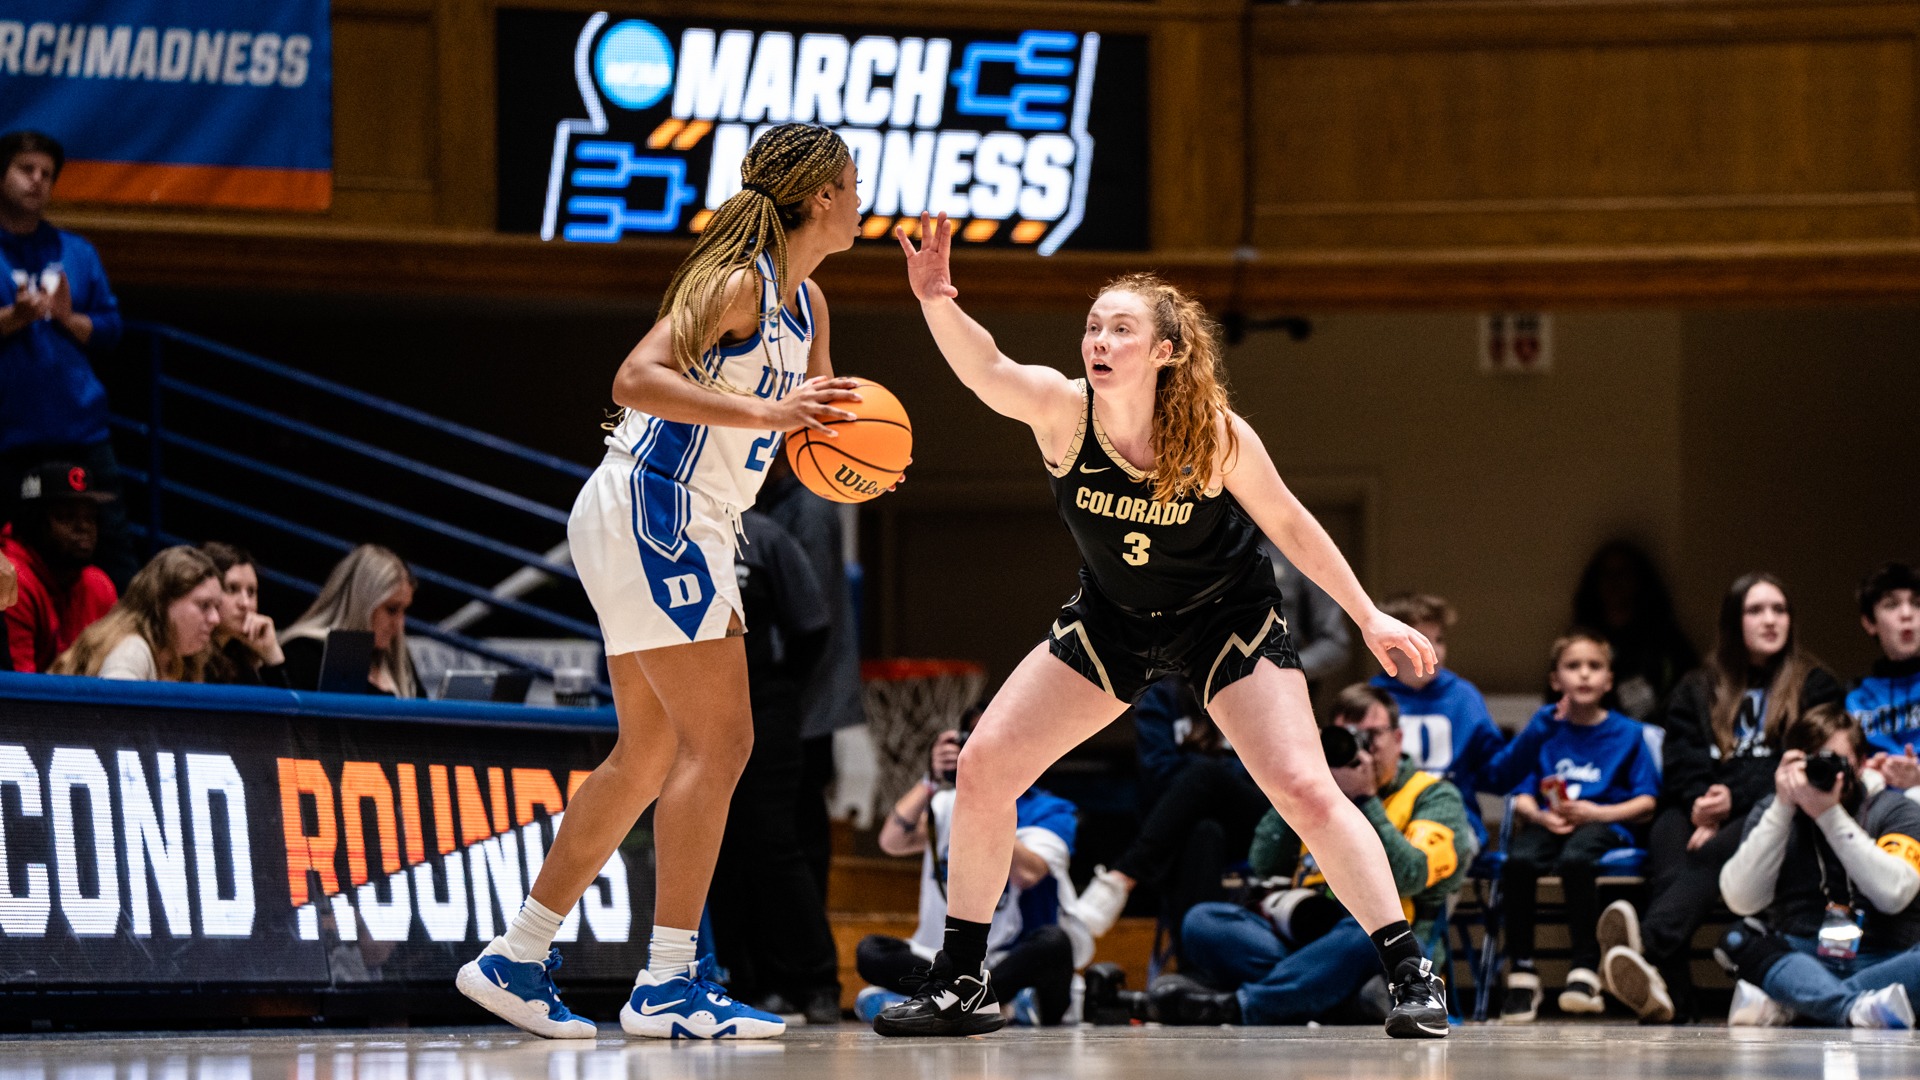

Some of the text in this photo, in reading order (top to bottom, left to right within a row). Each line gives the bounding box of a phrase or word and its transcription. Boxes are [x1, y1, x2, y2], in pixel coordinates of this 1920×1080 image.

[671, 28, 952, 128] MARCH
[705, 122, 1075, 221] MDNESS
[1076, 486, 1195, 526] COLORADO
[1122, 531, 1151, 567] 3
[662, 573, 703, 609] D
[0, 743, 256, 939] COND
